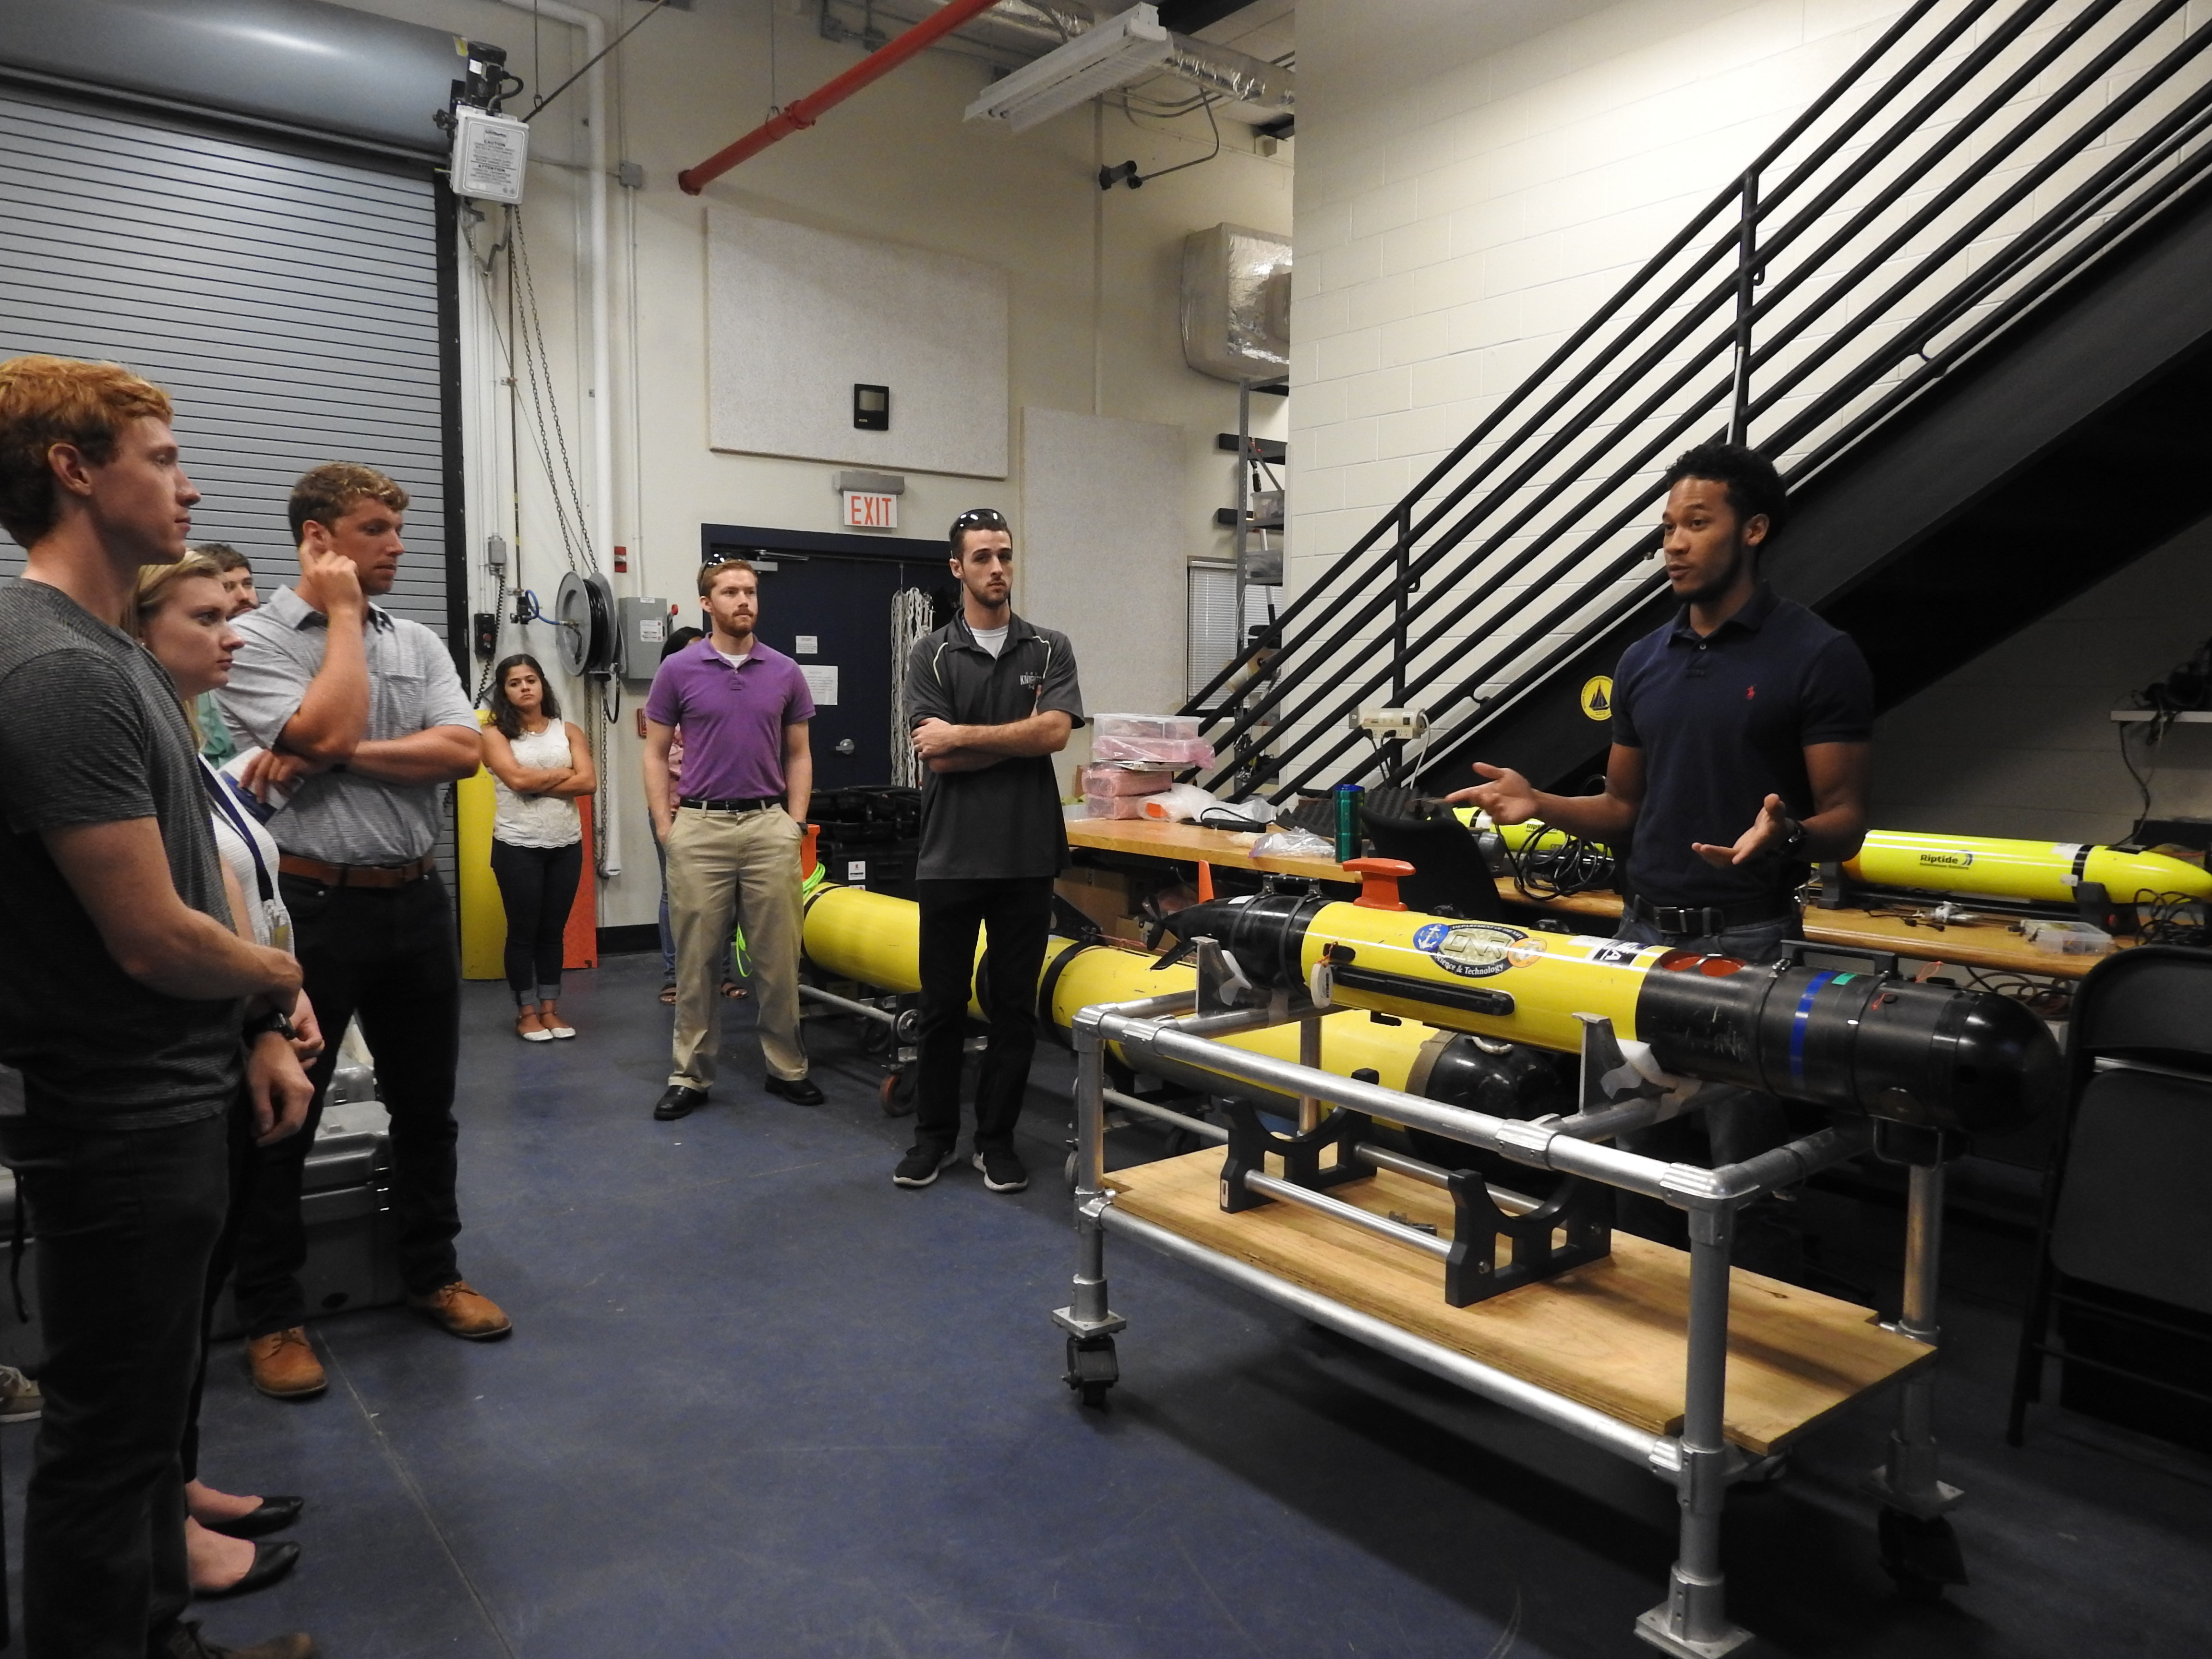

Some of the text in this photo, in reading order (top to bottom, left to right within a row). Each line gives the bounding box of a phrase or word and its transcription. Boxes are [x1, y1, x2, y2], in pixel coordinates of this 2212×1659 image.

[851, 495, 891, 526] EXIT
[1921, 854, 1958, 864] Riptide
[1456, 965, 1463, 973] &
[1465, 963, 1504, 975] Technology
